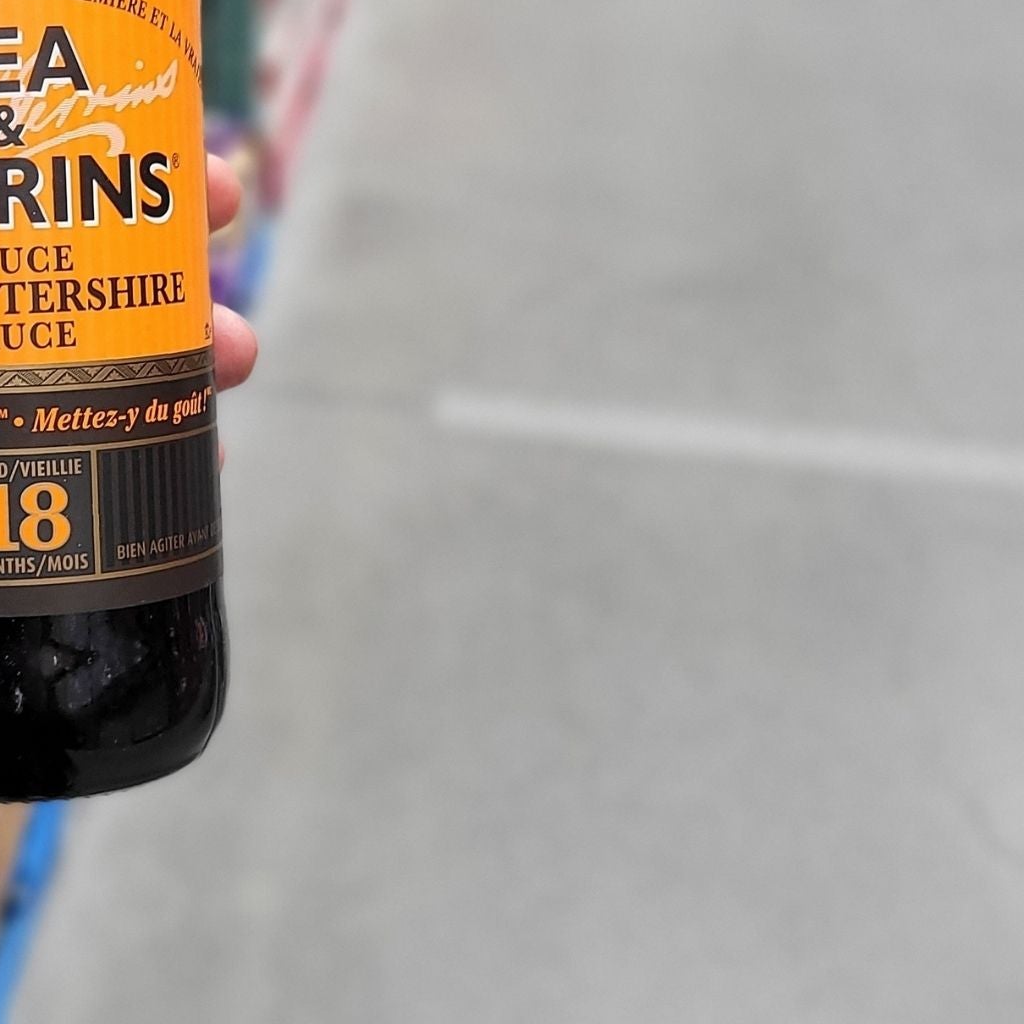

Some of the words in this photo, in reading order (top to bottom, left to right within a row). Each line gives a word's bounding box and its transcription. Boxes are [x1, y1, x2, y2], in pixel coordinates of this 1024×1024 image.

[150, 7, 169, 31] ET
[169, 21, 186, 48] LA
[184, 37, 202, 84] VRAI
[31, 406, 140, 432] Mettez-y
[145, 398, 169, 424] du
[117, 540, 146, 560] BIEN
[150, 534, 185, 555] AGITER
